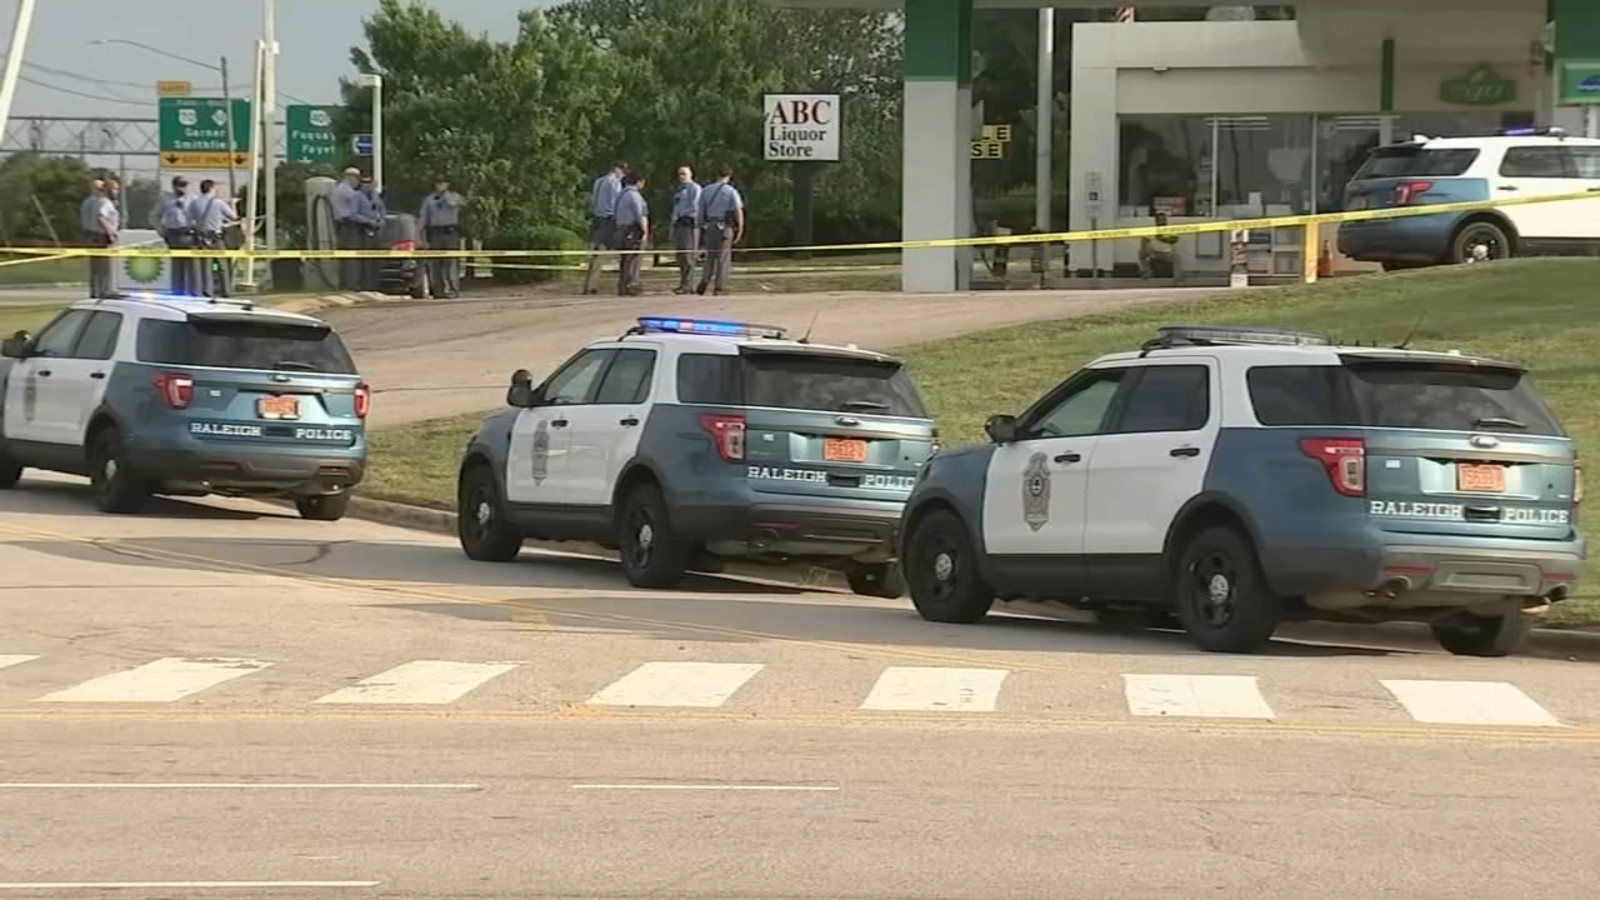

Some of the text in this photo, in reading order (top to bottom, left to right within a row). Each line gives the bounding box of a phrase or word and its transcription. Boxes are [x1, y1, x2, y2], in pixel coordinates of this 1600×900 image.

[769, 100, 831, 125] ABC
[184, 128, 226, 137] Garner
[769, 126, 827, 145] Liquor
[173, 140, 238, 150] Smithfied
[768, 142, 813, 157] Store
[191, 422, 352, 440] RALEIGH POLICE
[747, 466, 917, 490] RALEIGH POLIC
[1370, 499, 1569, 524] RALEIGH POLICE
